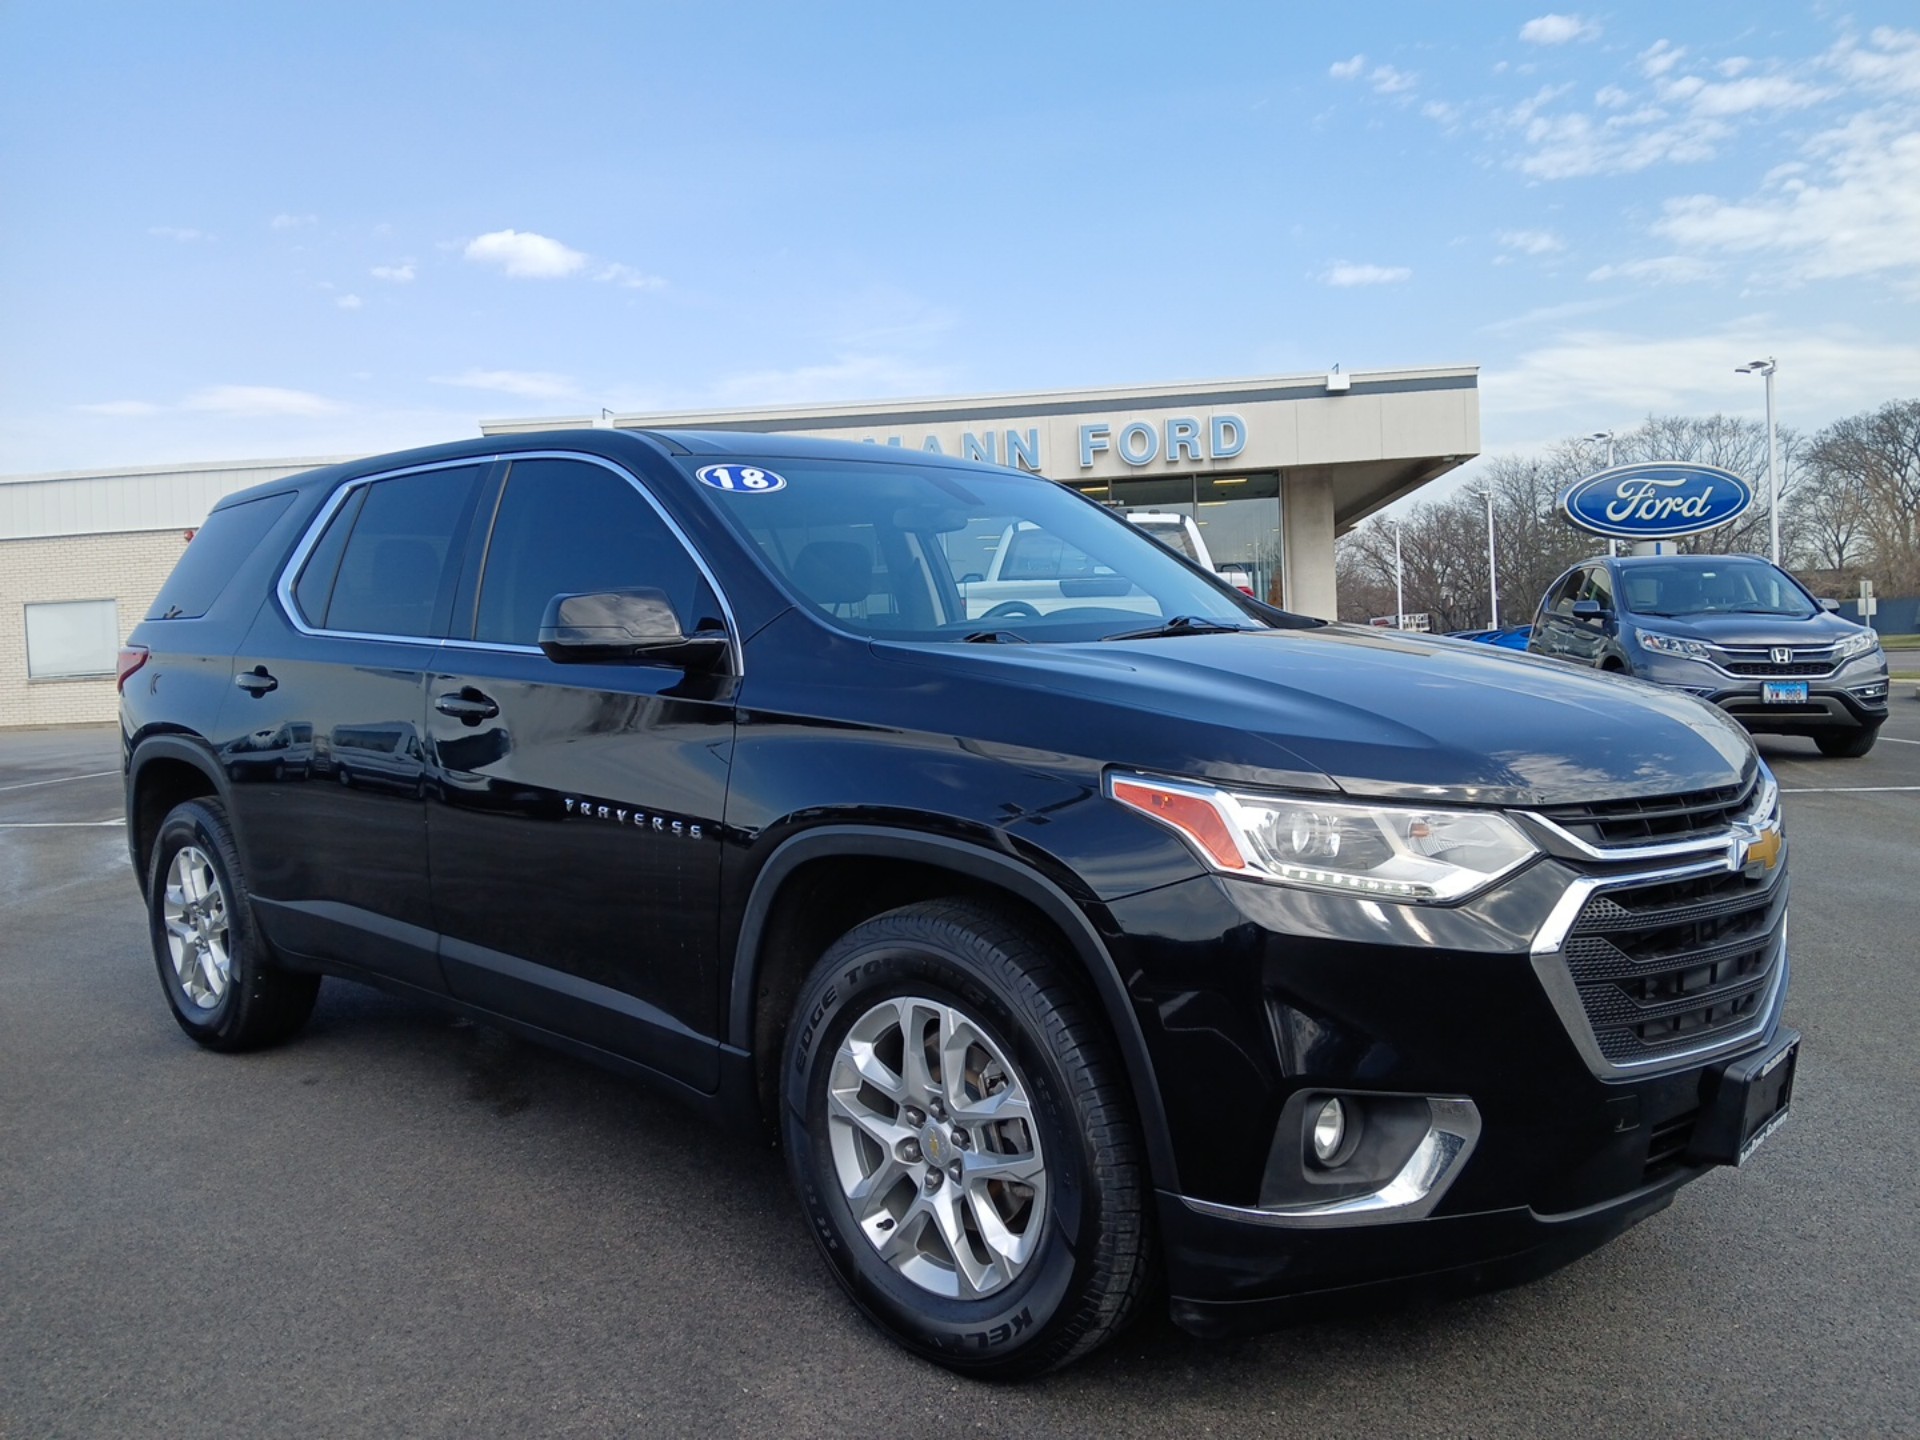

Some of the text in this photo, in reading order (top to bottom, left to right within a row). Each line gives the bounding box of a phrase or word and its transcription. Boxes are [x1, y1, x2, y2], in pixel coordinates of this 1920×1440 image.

[861, 412, 1248, 471] NN FORD
[712, 468, 769, 489] 18
[1606, 478, 1713, 521] Ford
[564, 798, 702, 839] TRAVERSE
[795, 985, 838, 1076] EDGE
[930, 1305, 1034, 1352] KEL
